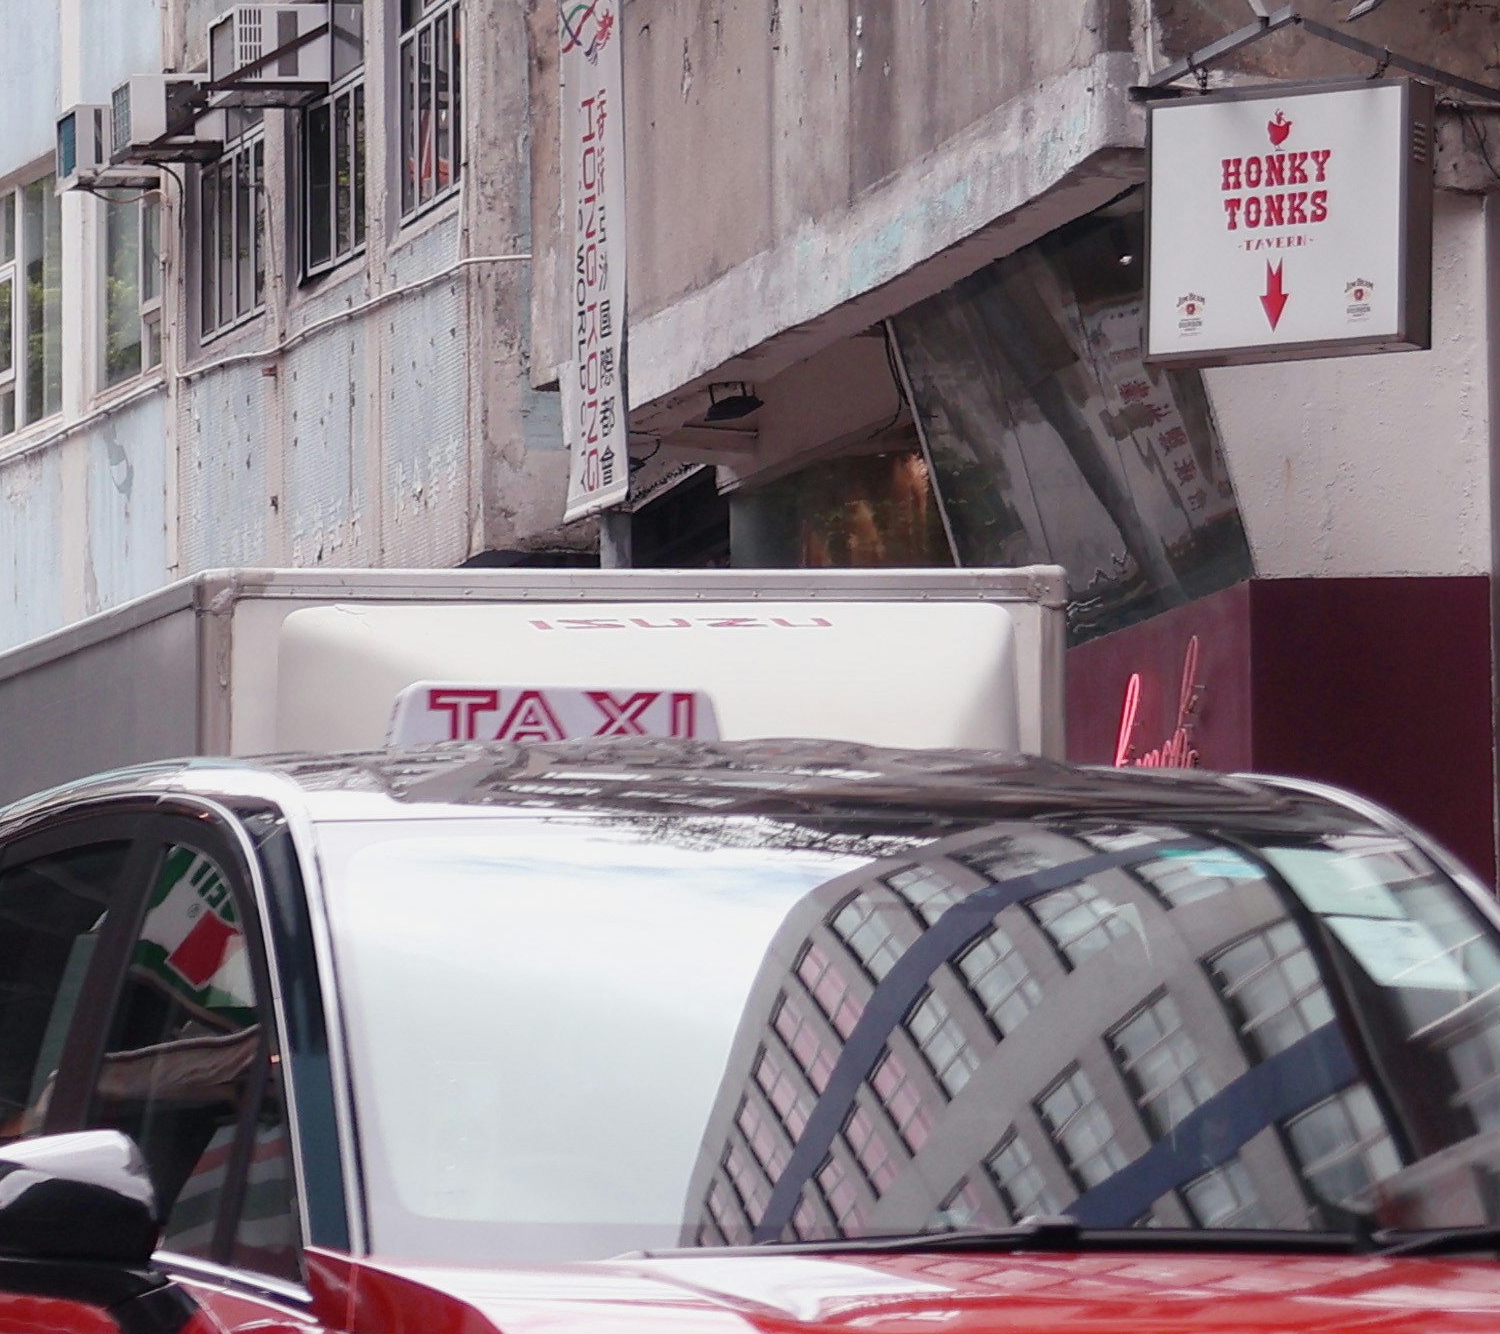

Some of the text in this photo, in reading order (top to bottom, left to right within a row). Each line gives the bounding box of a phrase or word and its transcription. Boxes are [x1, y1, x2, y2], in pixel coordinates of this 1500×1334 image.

[1221, 149, 1332, 191] HONKY
[1224, 190, 1328, 231] TONKS
[576, 244, 587, 390] WORLD
[581, 97, 600, 492] HONG KONG
[429, 689, 698, 742] TAXI
